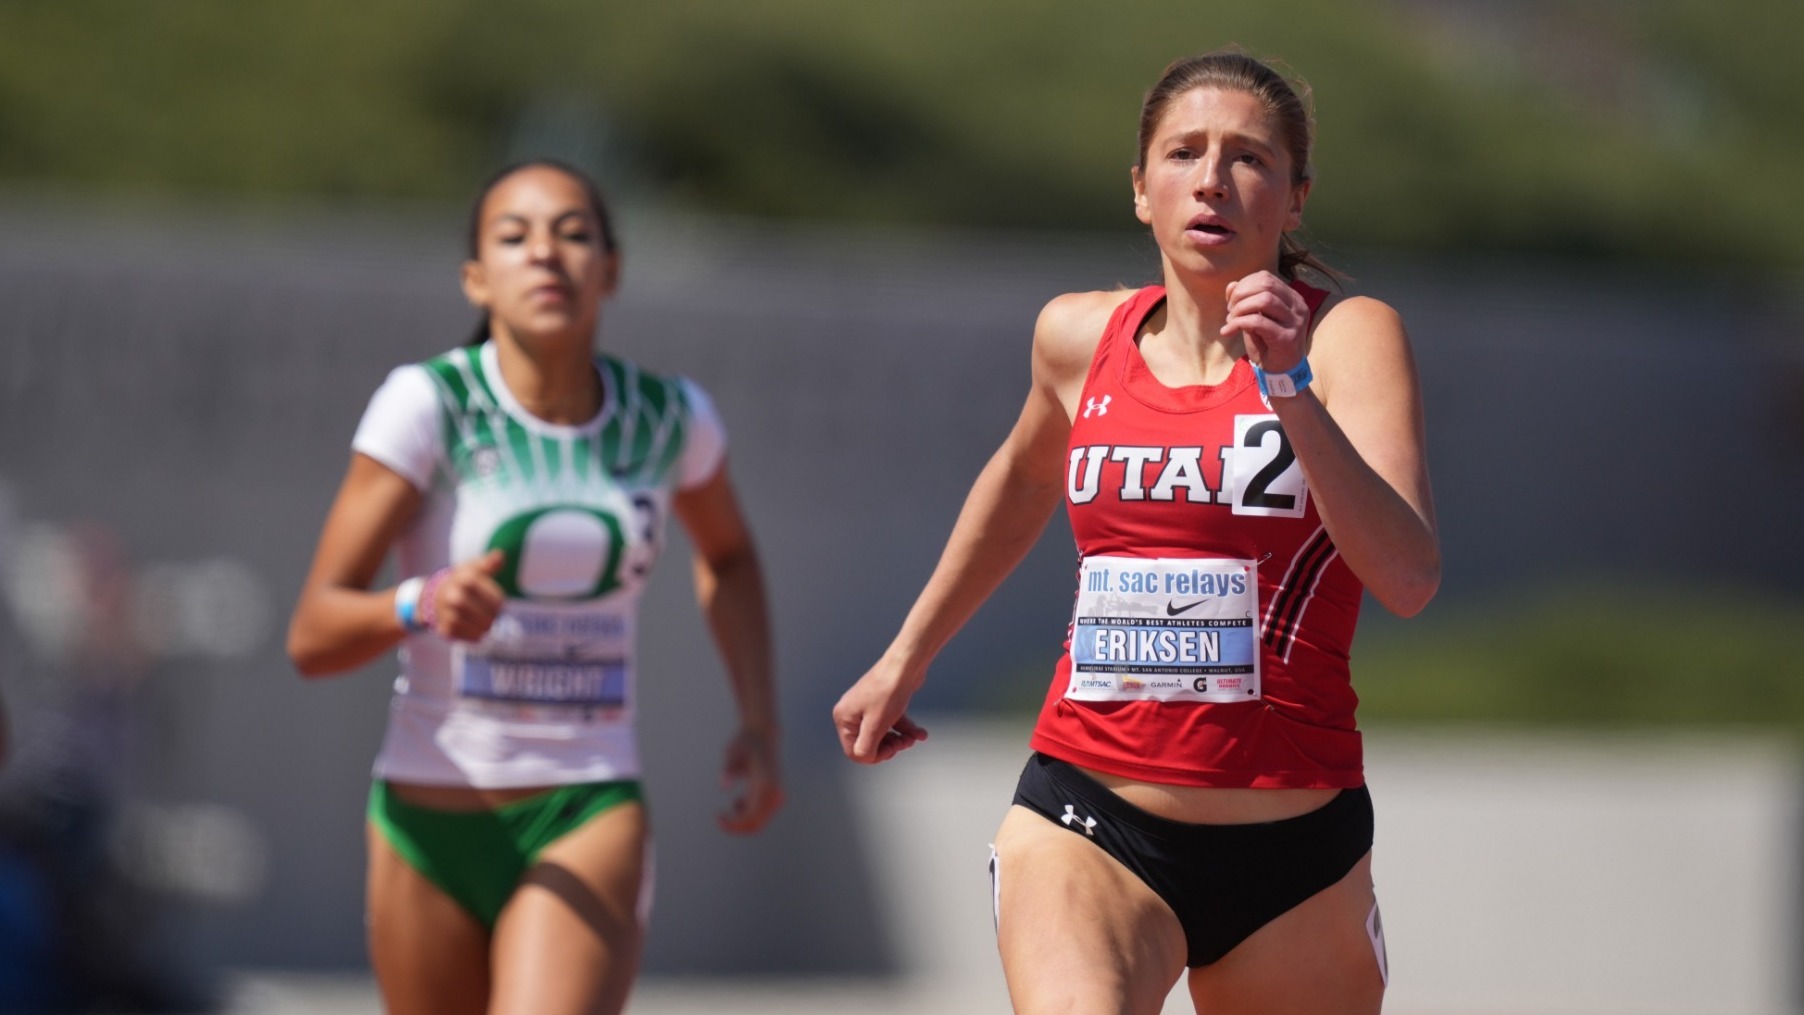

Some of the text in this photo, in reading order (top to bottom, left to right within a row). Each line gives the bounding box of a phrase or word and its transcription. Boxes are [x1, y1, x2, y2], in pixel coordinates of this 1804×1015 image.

[1242, 419, 1296, 510] 2
[486, 503, 627, 601] O
[1088, 568, 1246, 597] mt. sac relays
[1111, 618, 1143, 626] WORLD'S
[1146, 619, 1164, 627] BEST
[1095, 628, 1220, 663] ERIKSEN
[1193, 677, 1208, 693] G
